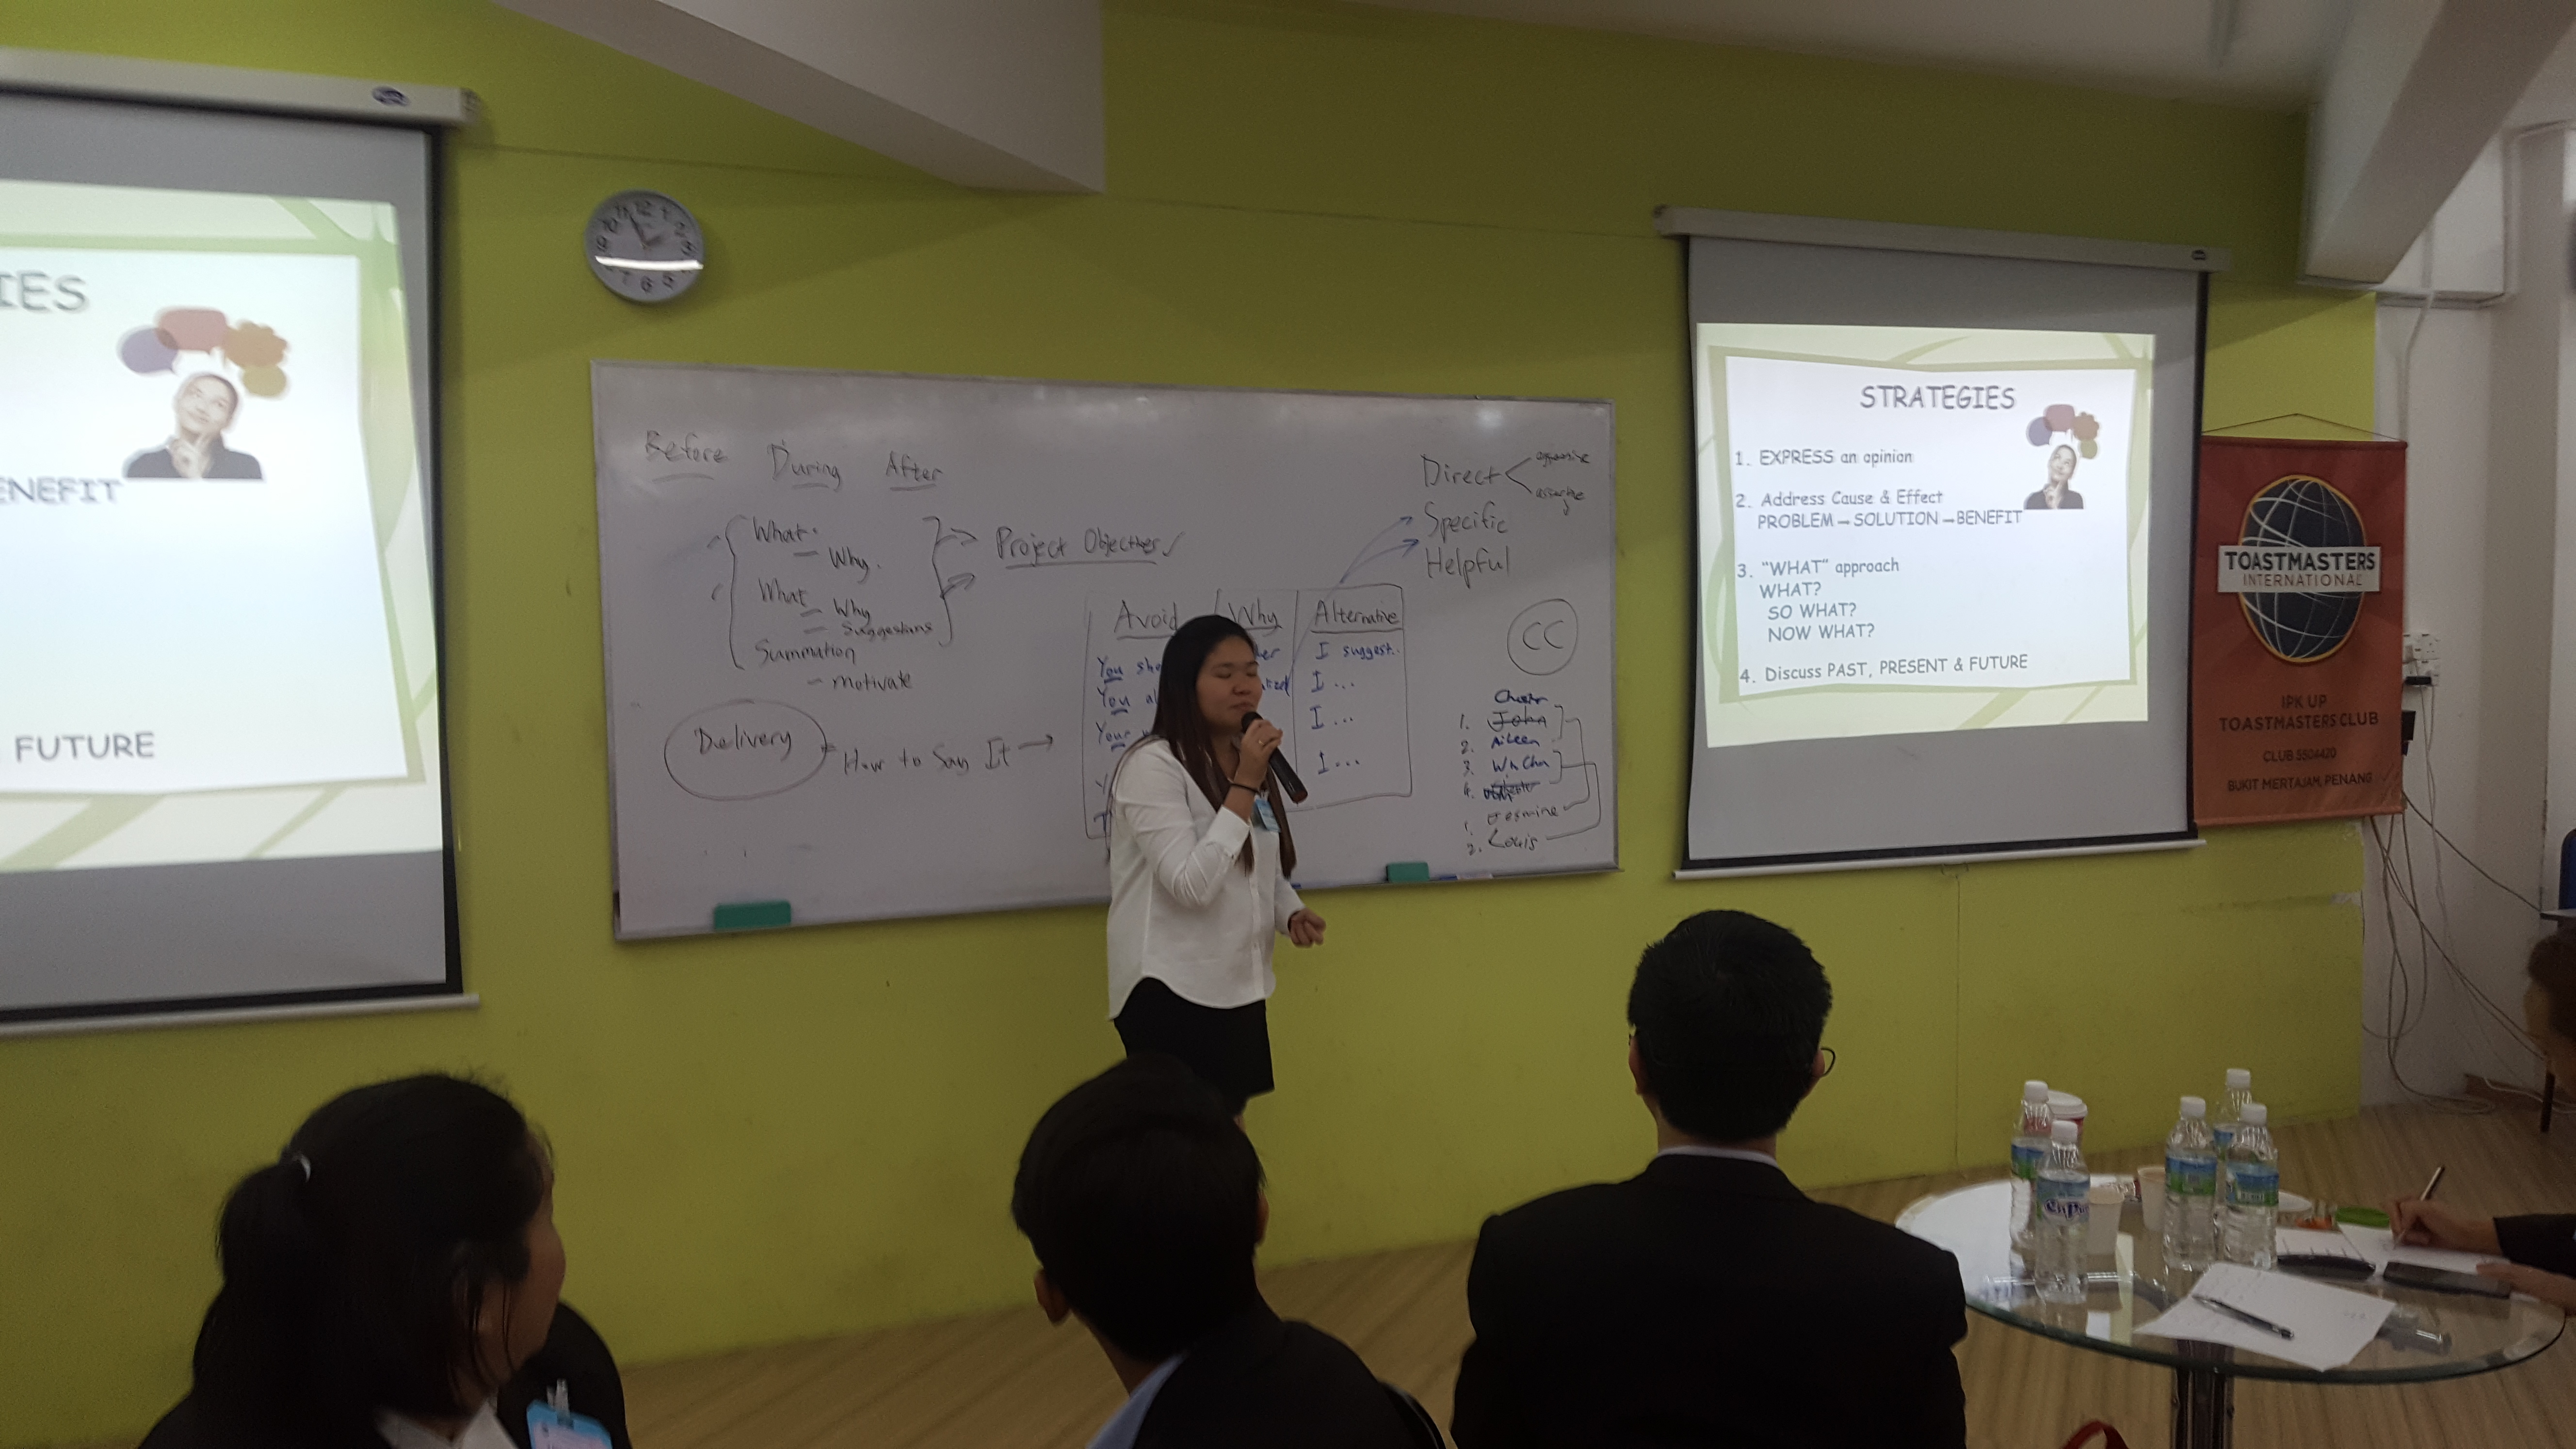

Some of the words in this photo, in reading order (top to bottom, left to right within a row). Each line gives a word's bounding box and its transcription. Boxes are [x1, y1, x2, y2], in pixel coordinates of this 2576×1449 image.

[1860, 385, 2016, 410] STRATEGIES
[645, 430, 727, 464] Before
[1736, 451, 1752, 466] 1.
[1759, 449, 1834, 466] EXPRESS
[1840, 451, 1857, 465] an
[1863, 450, 1914, 468] opinion
[767, 439, 842, 492] During
[886, 451, 943, 481] After
[1420, 454, 1502, 486] Direct
[1736, 494, 1752, 509] 2.
[1761, 492, 1825, 507] Address
[1831, 490, 1874, 505] Cause
[1880, 490, 1890, 505] &
[1896, 489, 1943, 504] Effect
[1425, 501, 1508, 543] Specific
[1758, 514, 1834, 531] PROBLEM
[1853, 511, 1939, 528] SOLUTION
[1956, 509, 2024, 526] BENEFIT
[996, 527, 1065, 566] Project
[1426, 546, 1509, 589] Helpful
[1737, 564, 1753, 578] 3.
[1835, 557, 1900, 577] approach
[2224, 551, 2375, 571] TOASTMASTERS
[759, 578, 806, 606] What
[1759, 581, 1821, 599] WHAT?
[2243, 573, 2363, 587] INTERNATIONAL
[833, 598, 870, 626] Why
[1114, 599, 1178, 632] Avoid
[1228, 597, 1283, 637] Why
[1315, 600, 1399, 625] Alternative
[1768, 604, 1793, 621] SO
[1799, 602, 1857, 619] WHAT?
[1523, 620, 1564, 650] CC
[1768, 625, 1811, 643] NOW
[1819, 623, 1875, 640] WHAT?
[1097, 655, 1123, 677] You
[1740, 668, 1756, 684] 4.
[1765, 665, 1822, 682] Discuss
[1827, 662, 1873, 678] PAST,
[1880, 659, 1948, 675] PRESENT
[1953, 657, 1964, 672] &
[1969, 654, 2028, 672] FUTURE
[1097, 686, 1130, 708] You
[2307, 694, 2327, 708] UP
[2219, 714, 2336, 732] TOASTMASTERS
[2340, 711, 2379, 726] CLUB
[15, 731, 155, 763] FUTURE
[694, 724, 792, 761] Delivery
[844, 748, 885, 775] How
[900, 748, 921, 768] to
[2263, 750, 2294, 762] CLUB
[2227, 778, 2258, 792] BUKIT
[2325, 772, 2373, 786] PENANG
